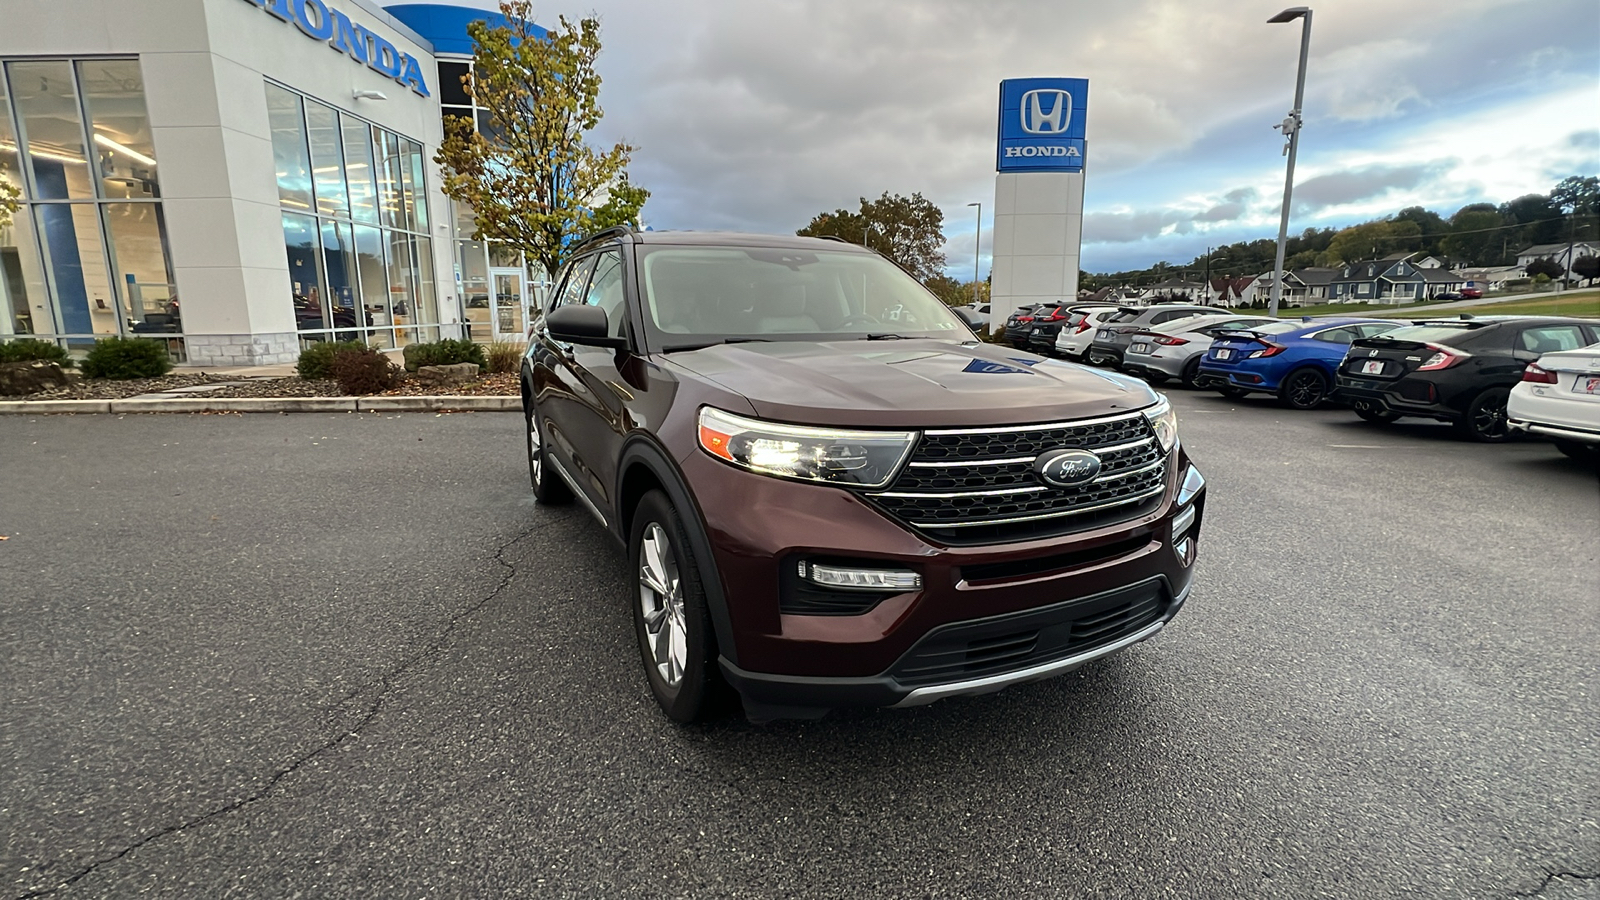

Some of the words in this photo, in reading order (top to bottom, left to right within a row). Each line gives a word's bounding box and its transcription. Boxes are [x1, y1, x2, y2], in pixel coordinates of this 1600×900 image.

[243, 0, 430, 97] ONDA
[1004, 145, 1082, 158] HONDA
[1060, 459, 1091, 479] Ford
